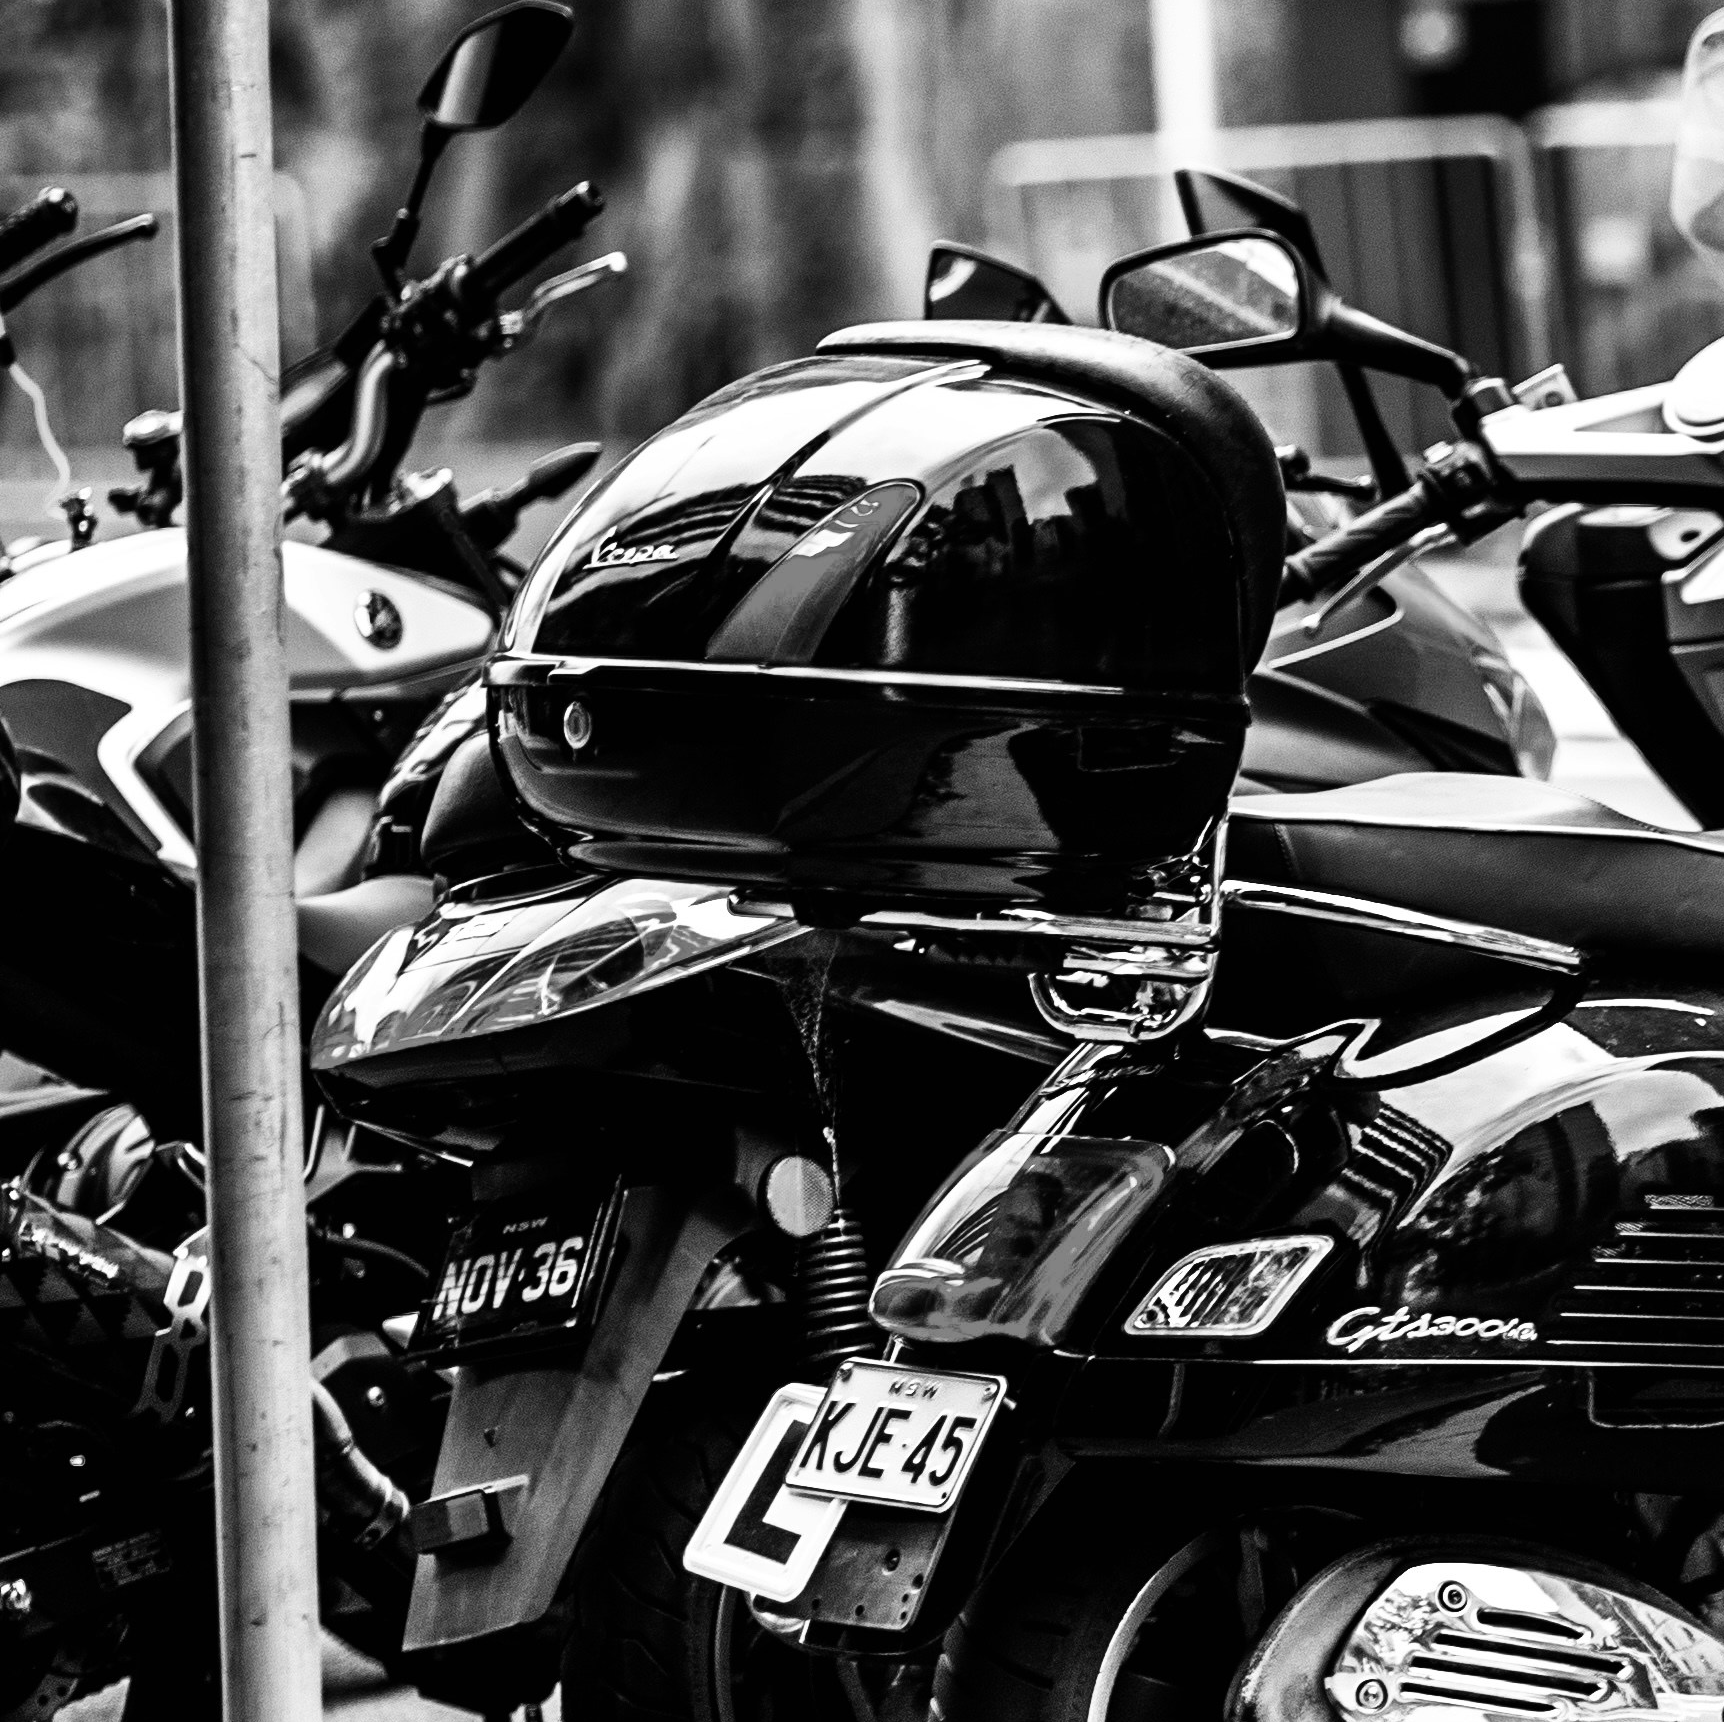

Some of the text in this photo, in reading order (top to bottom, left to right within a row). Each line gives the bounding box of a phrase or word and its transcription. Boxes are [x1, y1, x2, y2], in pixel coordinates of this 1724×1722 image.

[583, 526, 679, 570] Vespa
[502, 1217, 549, 1234] NSW
[888, 1379, 938, 1399] NSW
[725, 1420, 810, 1564] L
